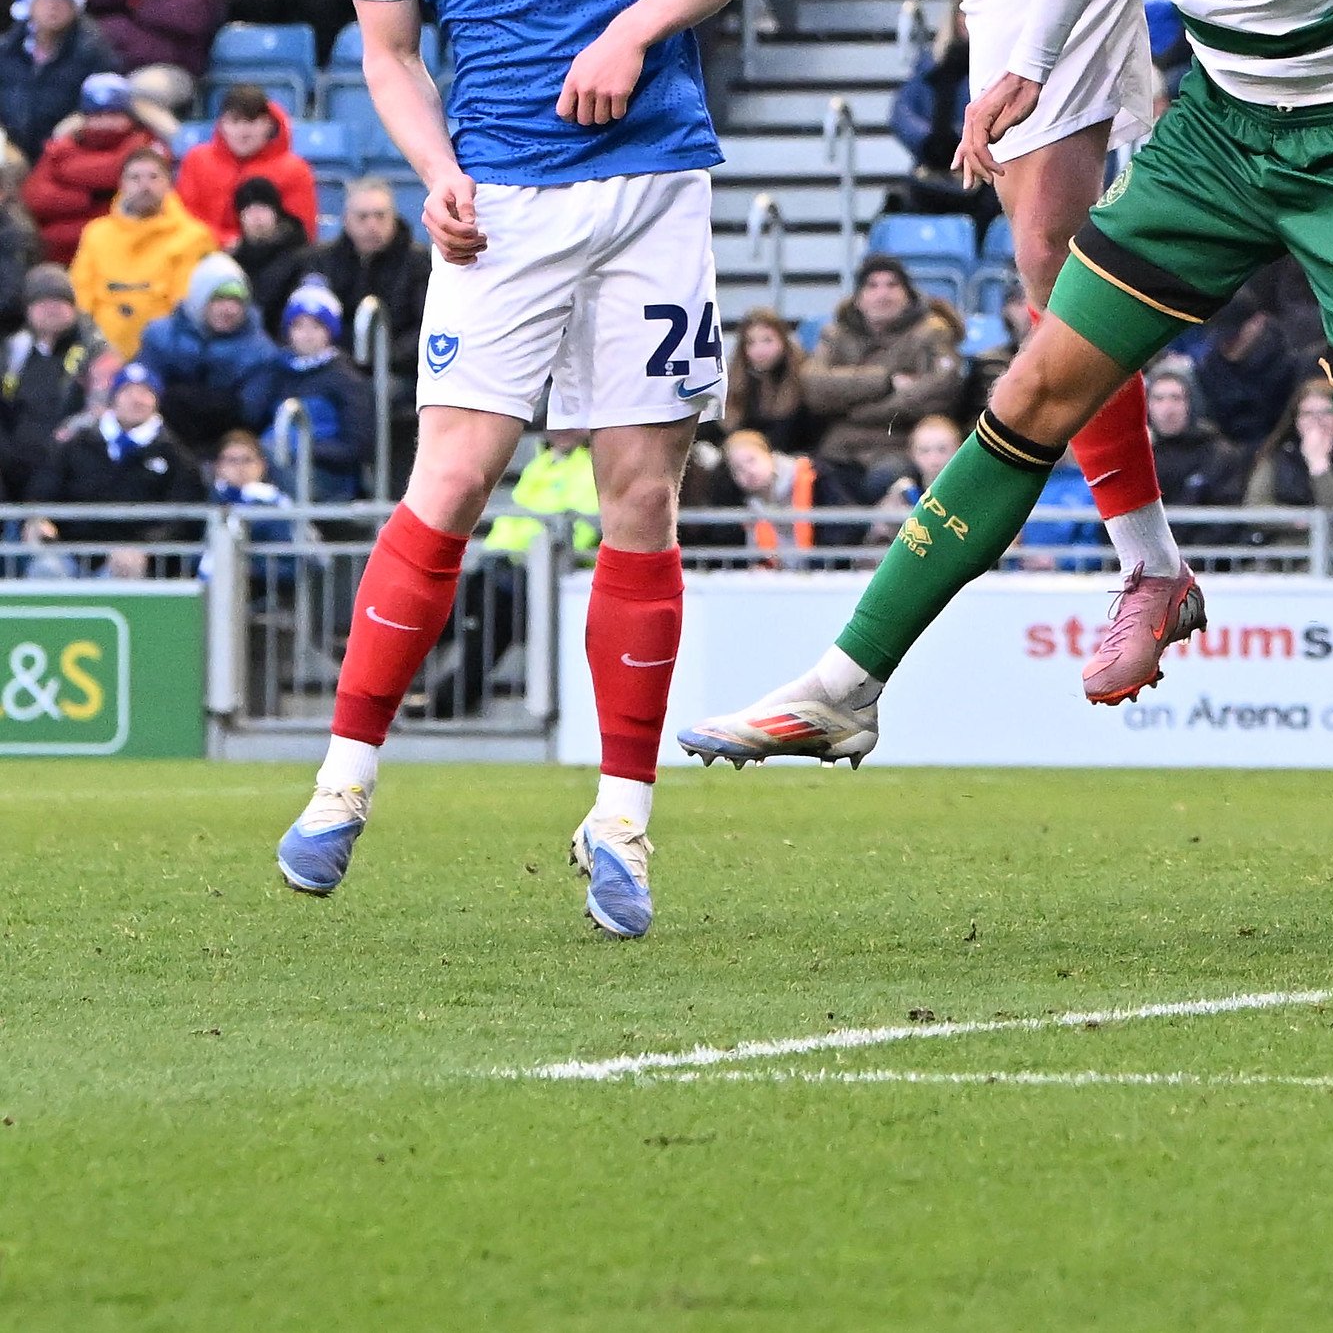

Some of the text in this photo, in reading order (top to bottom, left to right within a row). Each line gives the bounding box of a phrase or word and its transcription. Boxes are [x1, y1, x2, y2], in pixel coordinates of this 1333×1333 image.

[644, 302, 724, 377] 24
[1, 640, 103, 721] &S
[1123, 704, 1174, 730] an
[1187, 696, 1310, 729] Arena
